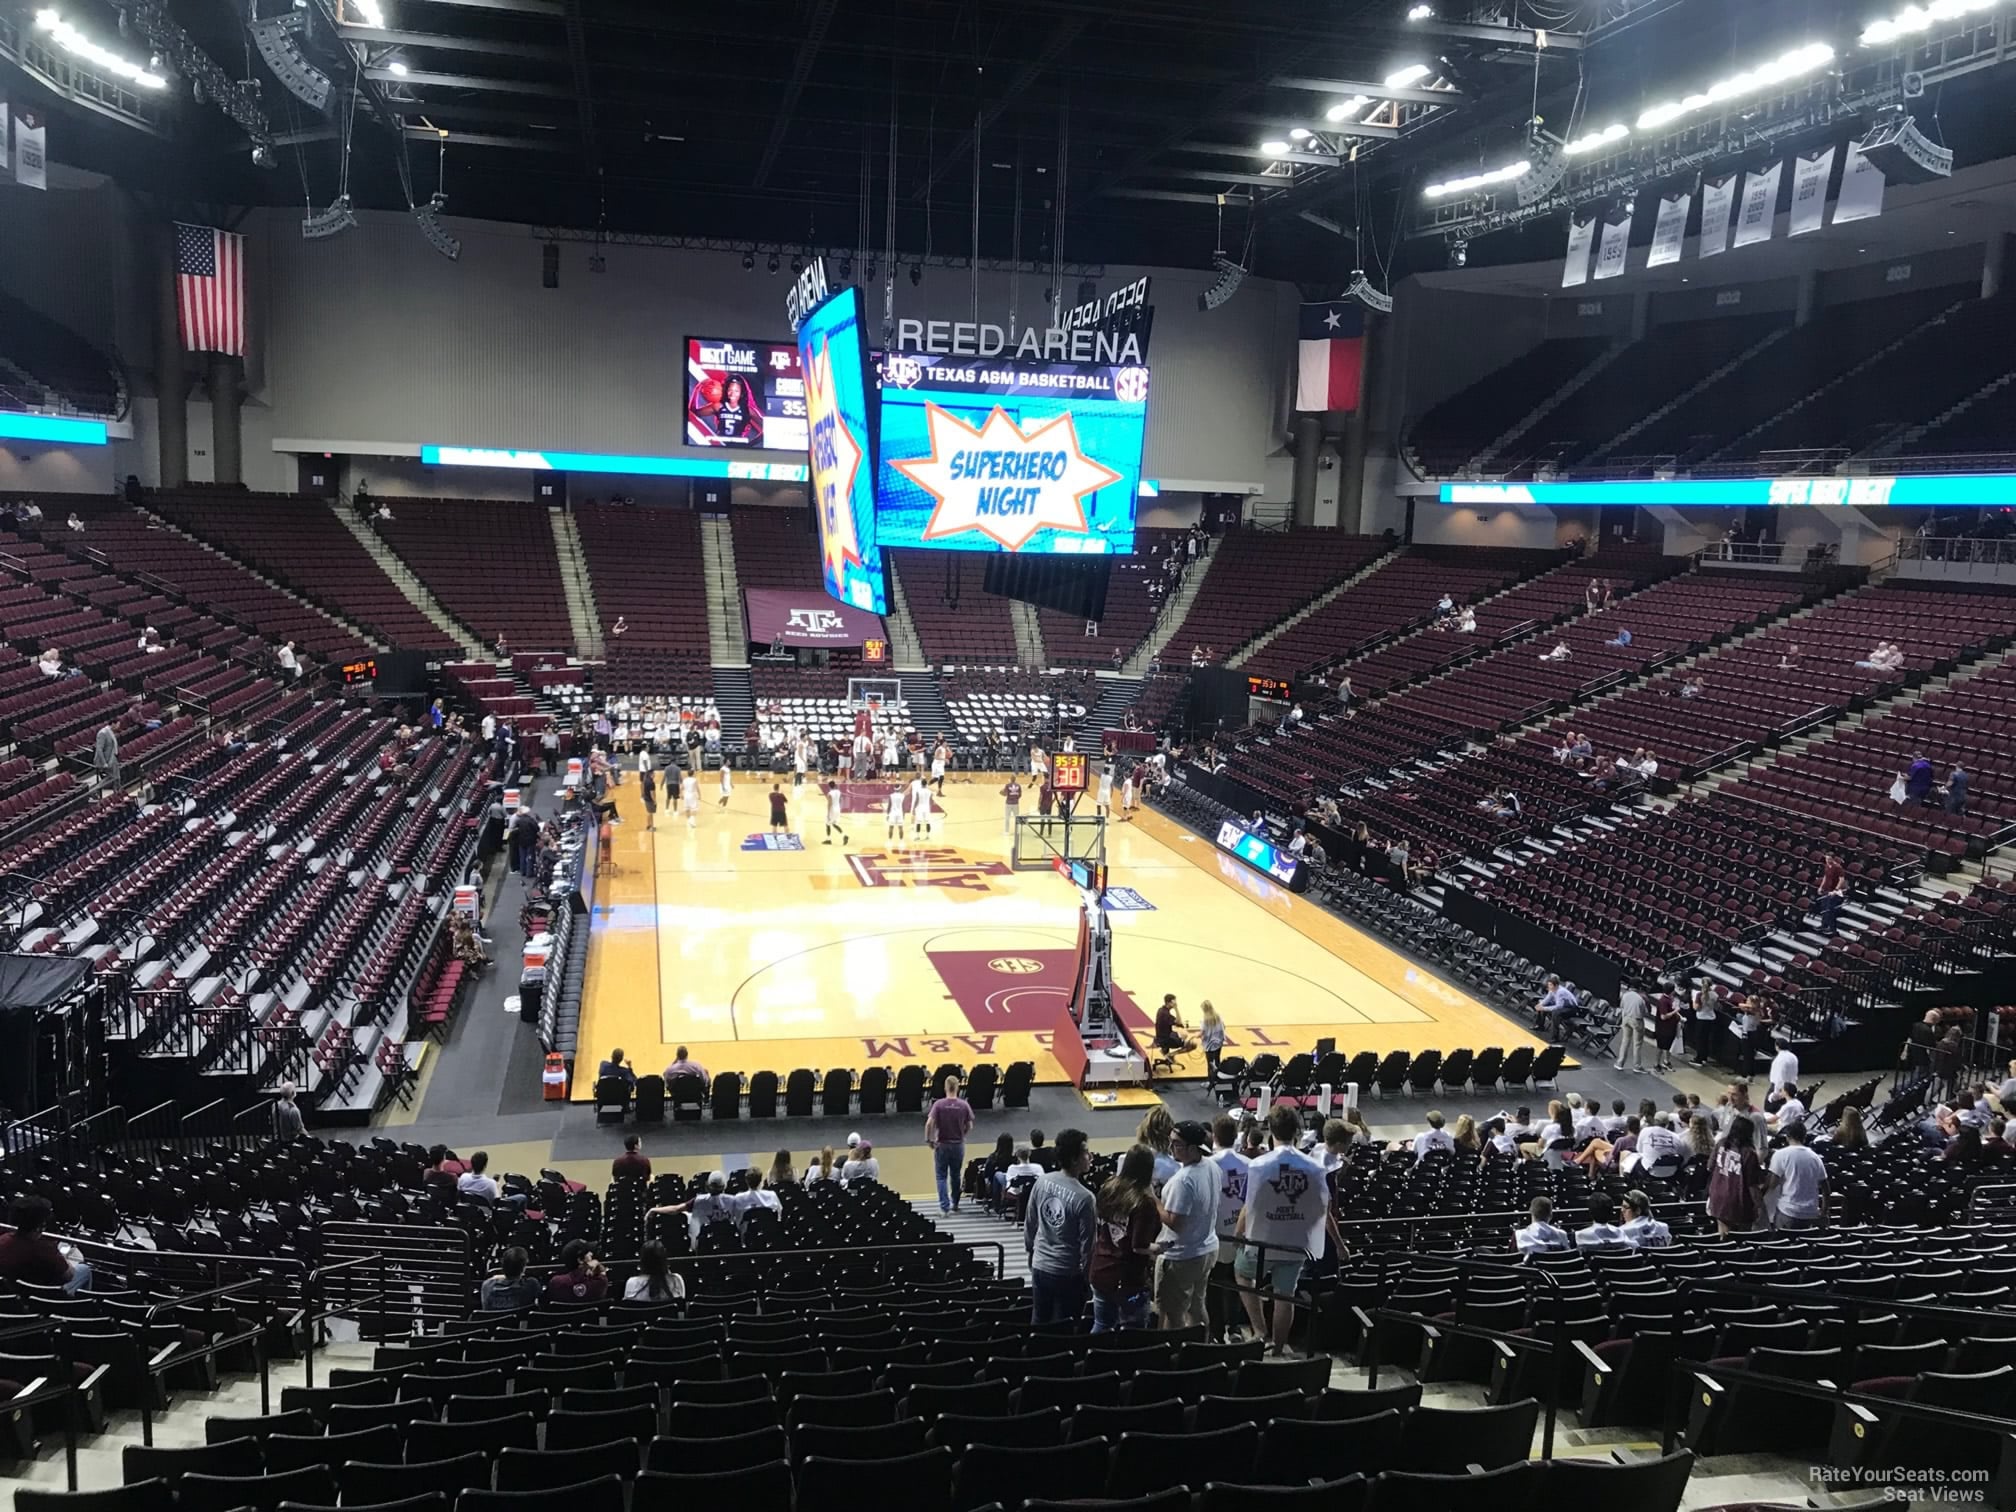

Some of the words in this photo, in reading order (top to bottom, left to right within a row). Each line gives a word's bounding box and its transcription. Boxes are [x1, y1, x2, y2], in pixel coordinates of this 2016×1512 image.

[898, 318, 1005, 356] REED
[1015, 327, 1142, 364] ARENA
[728, 350, 756, 366] GAME
[926, 366, 975, 383] TEXAS
[979, 369, 1015, 385] A&M
[1019, 371, 1111, 390] BASKETBALL
[1117, 368, 1149, 398] SEC
[950, 450, 1067, 481] SUPERHERO
[976, 486, 1041, 516] NIGHT
[1055, 755, 1085, 767] 35:31
[1058, 767, 1080, 786] 30
